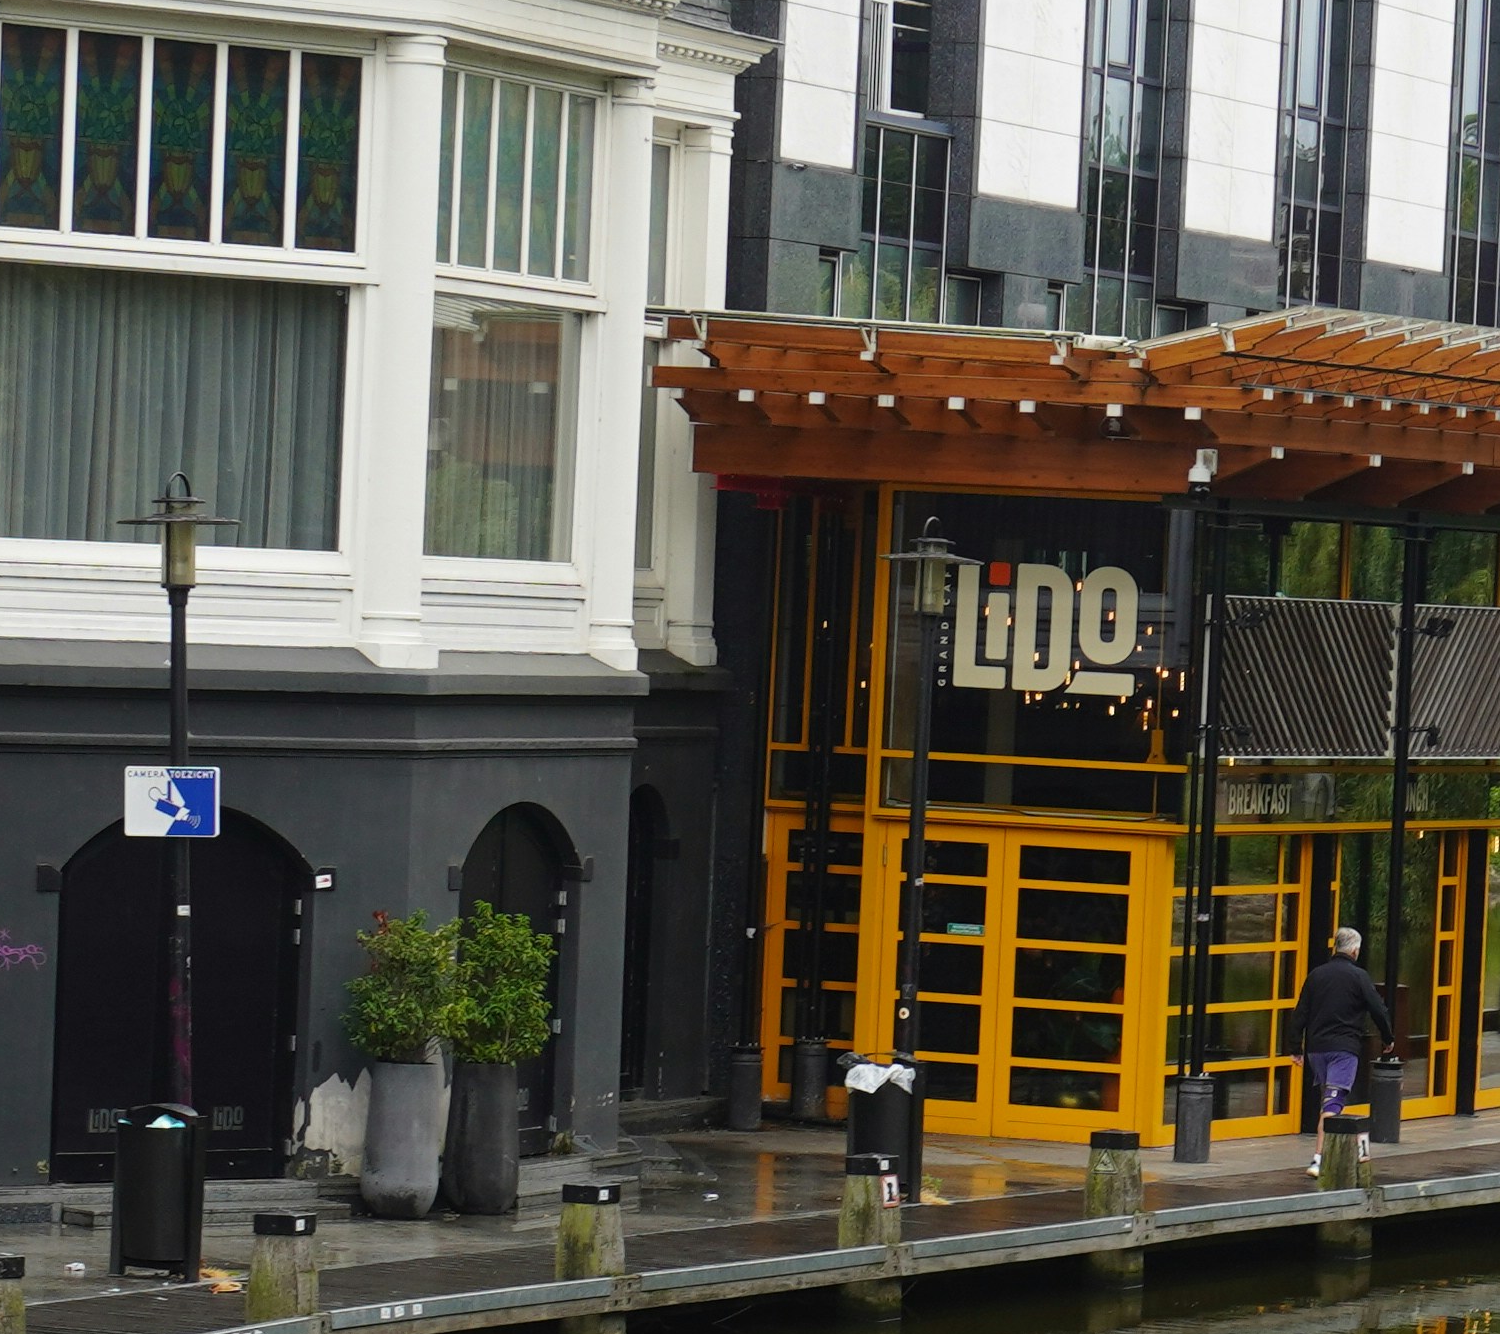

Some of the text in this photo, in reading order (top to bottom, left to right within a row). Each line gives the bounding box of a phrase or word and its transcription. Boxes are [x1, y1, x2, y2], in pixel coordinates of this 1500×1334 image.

[937, 621, 950, 687] GRAND
[127, 769, 215, 779] CAMERA TOEZICHT
[1227, 783, 1293, 816] BREAKFAST
